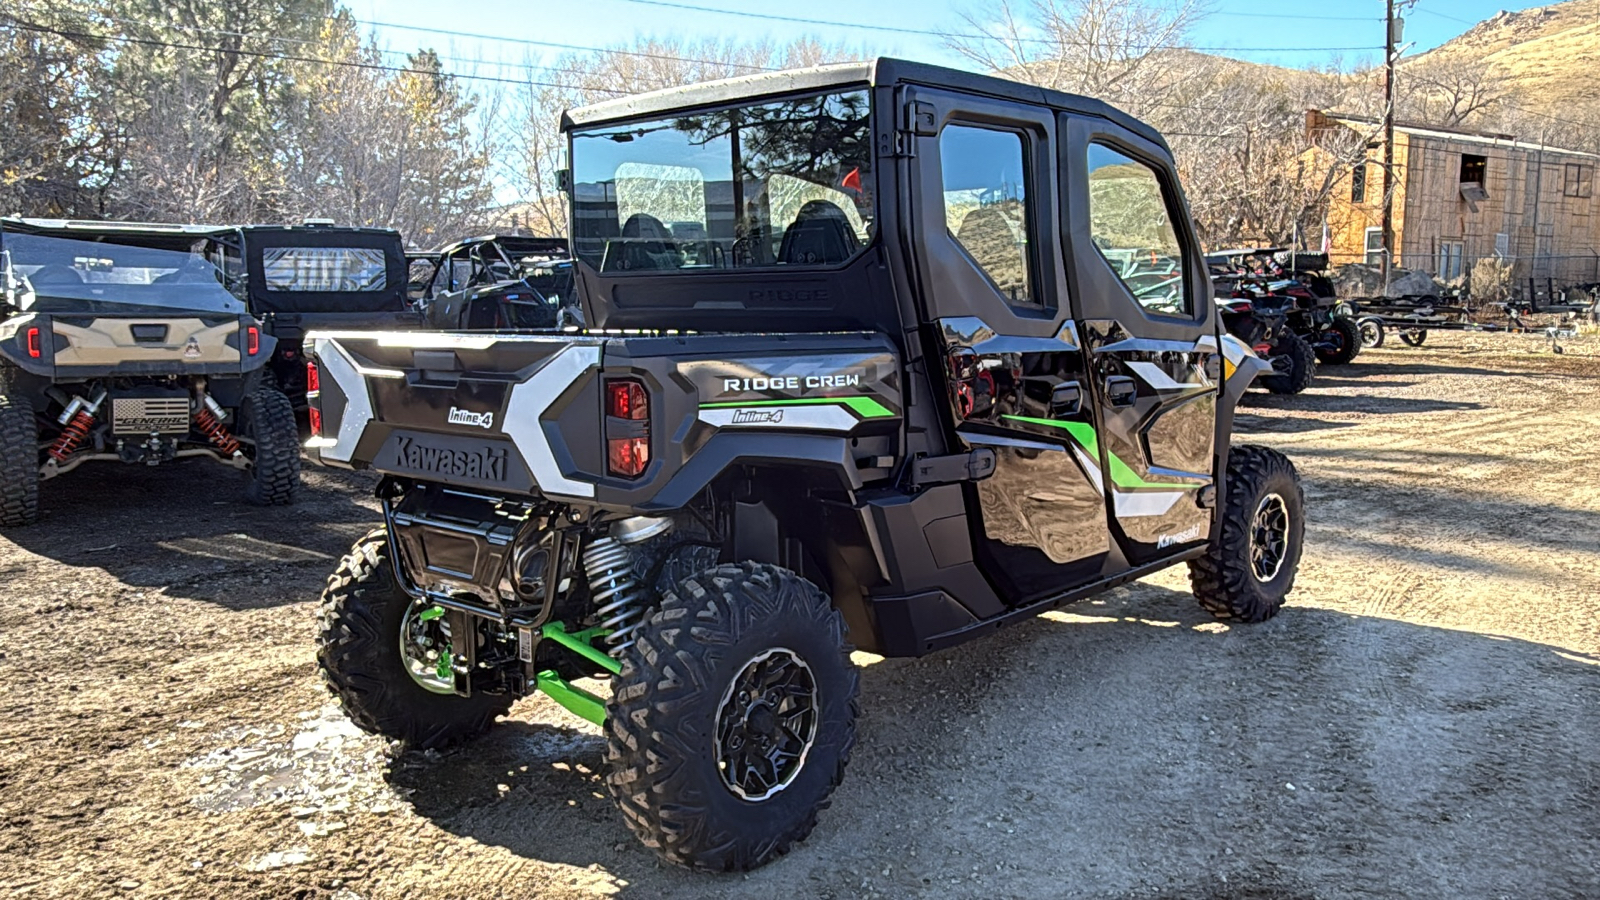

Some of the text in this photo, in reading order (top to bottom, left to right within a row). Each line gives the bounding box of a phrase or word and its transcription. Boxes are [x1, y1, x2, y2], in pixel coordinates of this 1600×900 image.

[724, 375, 859, 391] RIDGE CREW
[448, 407, 493, 428] Inline-4
[732, 410, 784, 423] Inline-4
[395, 435, 508, 481] Kawasaki
[1157, 523, 1201, 550] Kawasaki
